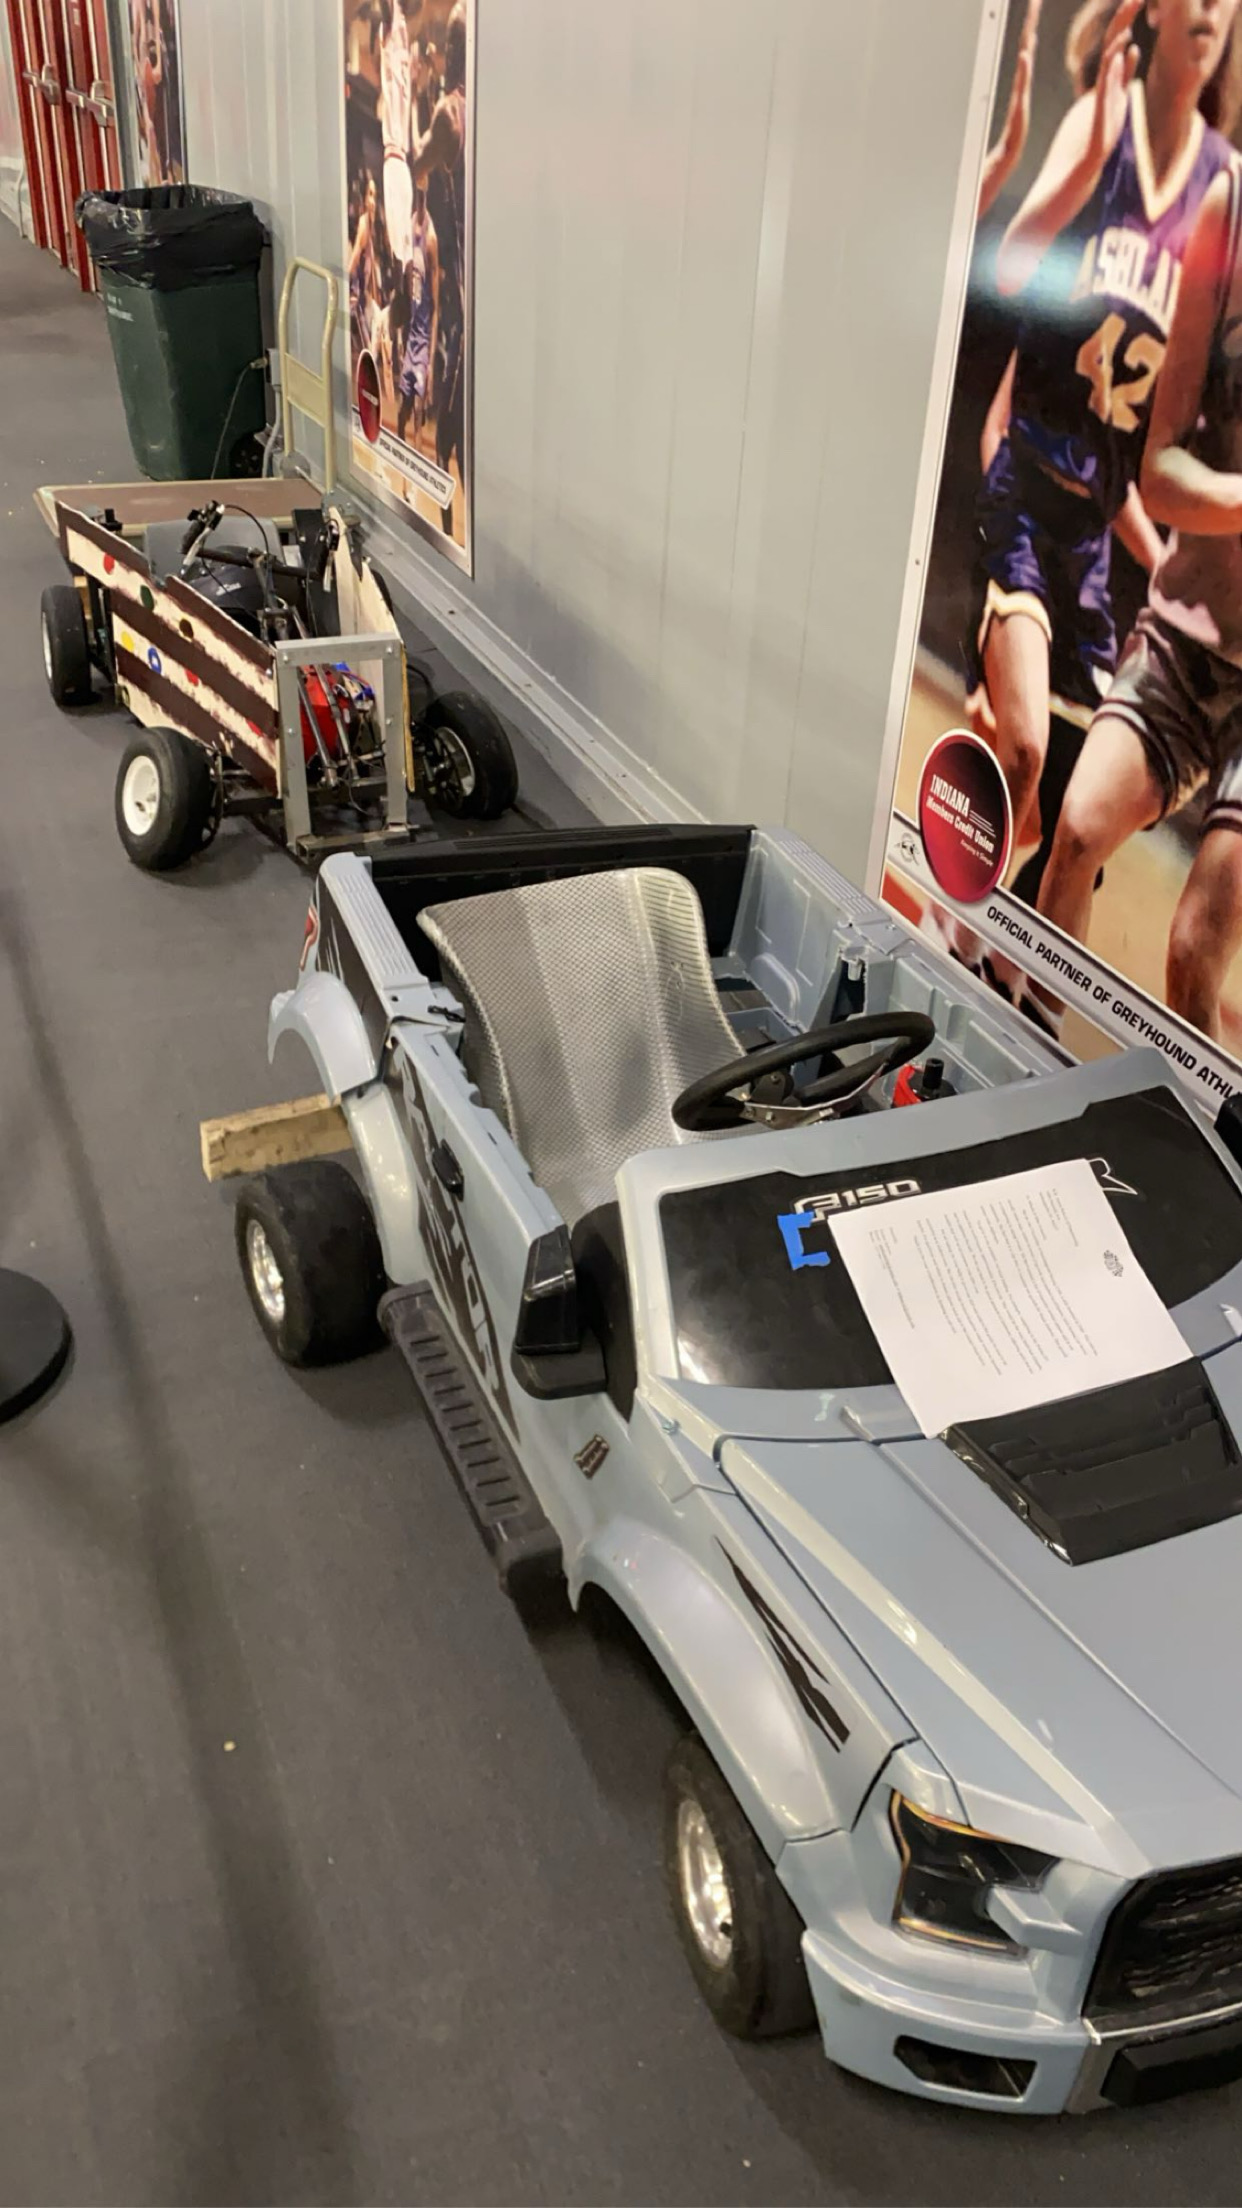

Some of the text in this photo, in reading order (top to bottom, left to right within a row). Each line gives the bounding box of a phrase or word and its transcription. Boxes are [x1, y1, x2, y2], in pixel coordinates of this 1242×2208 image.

[1075, 311, 1168, 434] 42
[926, 795, 994, 854] Members Credit Union
[930, 774, 970, 818] INDIANA
[987, 906, 1237, 1099] OFFICIAL PARTNER OF GREYHOUND ATHL
